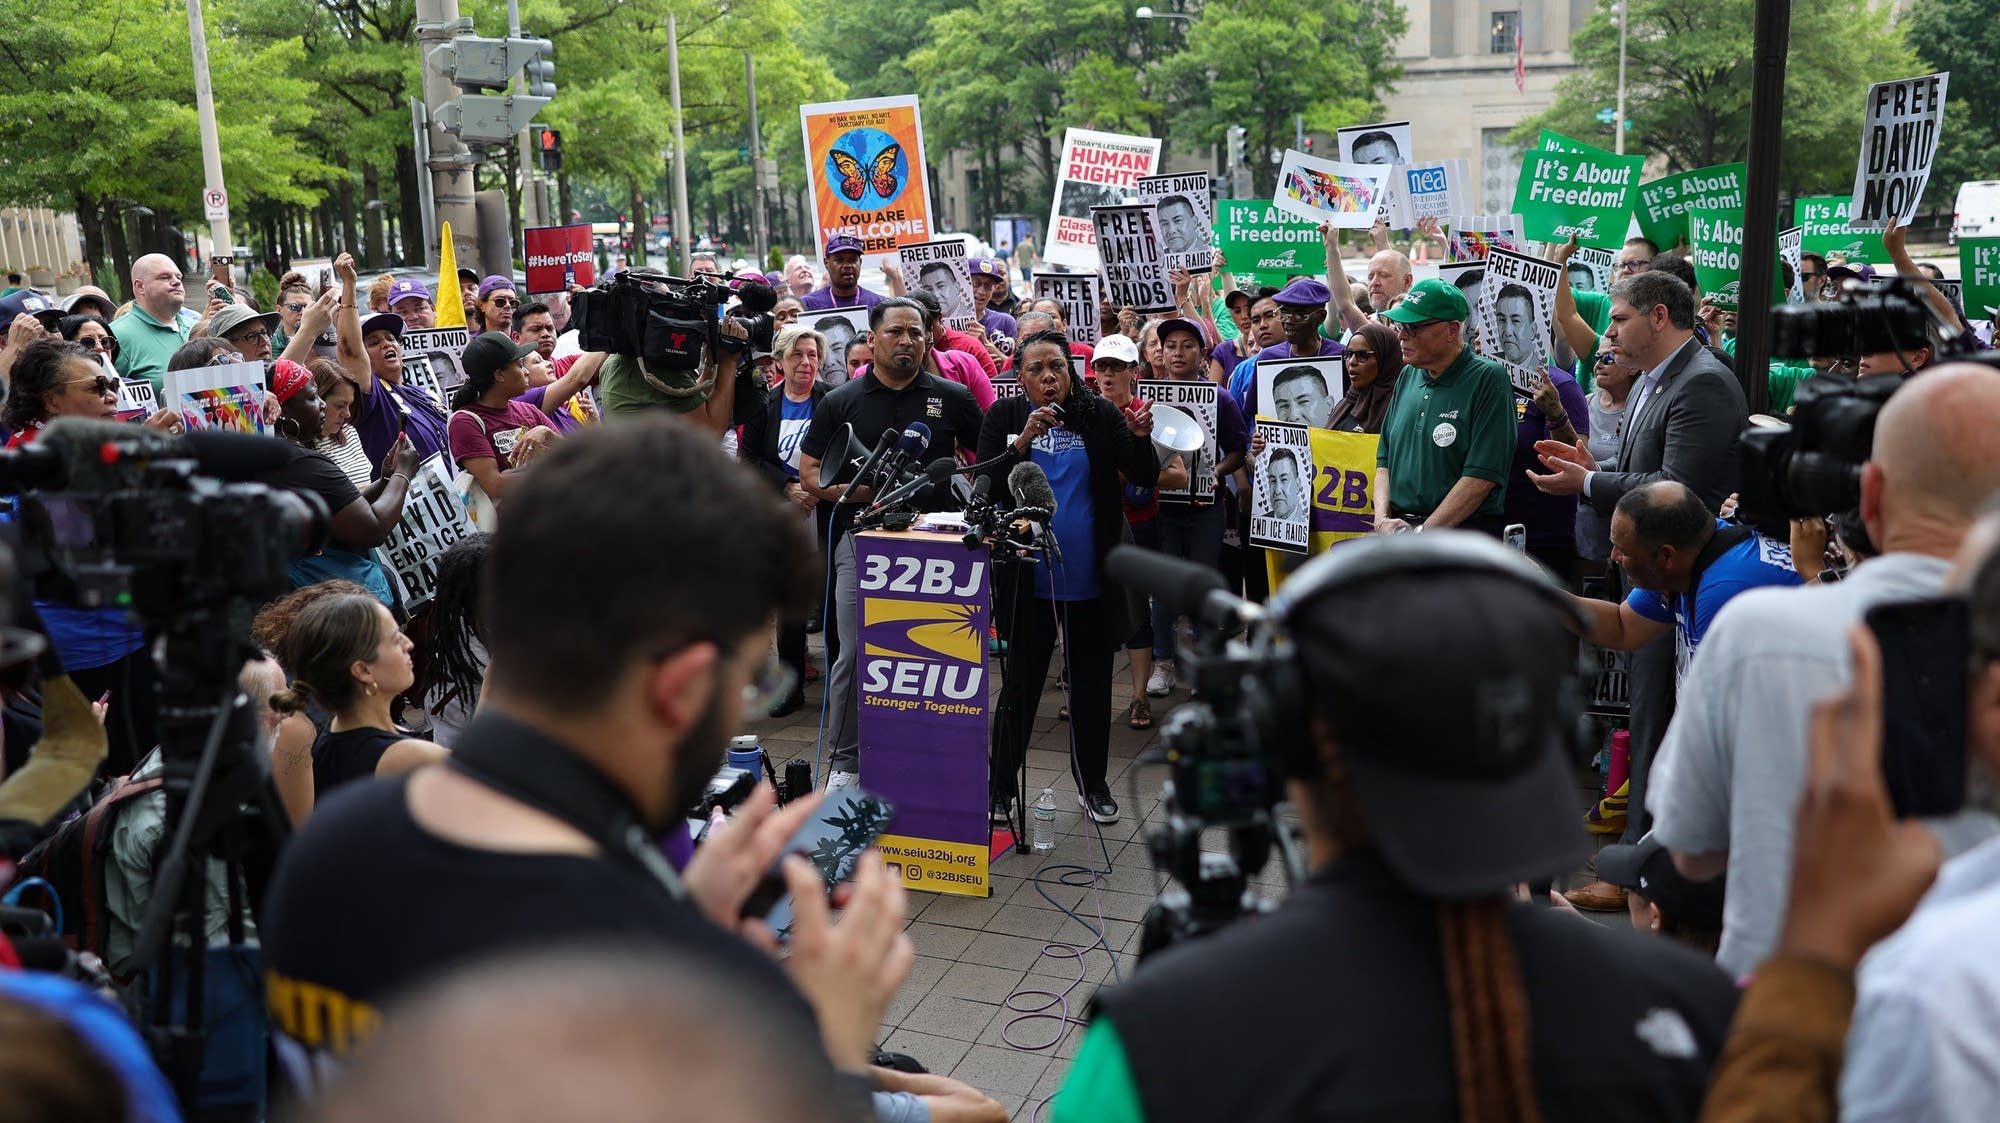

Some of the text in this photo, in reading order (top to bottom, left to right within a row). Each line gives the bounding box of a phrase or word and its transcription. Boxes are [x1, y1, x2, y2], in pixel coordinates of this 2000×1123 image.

[1875, 78, 1940, 119] FREE
[1072, 139, 1101, 149] TODAY'S
[1102, 143, 1130, 152] LESSON
[1868, 119, 1935, 174] DAVID
[1071, 147, 1151, 171] HUMAN
[1068, 163, 1146, 189] RIGHTS
[1410, 170, 1446, 193] nea
[1535, 158, 1631, 185] It's About
[1139, 176, 1207, 195] FREE DAVID
[1529, 180, 1627, 208] Freedom!
[1642, 172, 1739, 207] It's About
[1649, 190, 1742, 224] Freedom!
[1861, 175, 1924, 221] NOW
[840, 209, 906, 226] YOU ARE
[1230, 206, 1259, 224] It's
[1804, 203, 1831, 220] It's
[823, 219, 925, 240] WELCOME
[1099, 211, 1154, 236] FREE
[1230, 225, 1321, 243] Freedom!
[1693, 216, 1710, 242] It's
[1057, 230, 1084, 244] Not
[1779, 231, 1800, 251] DAVID
[528, 250, 593, 268] #HereToStay
[901, 243, 966, 263] FREE DAVID
[1102, 235, 1158, 264] DAVID
[1166, 251, 1212, 270] ICE RAIDS
[1584, 250, 1612, 267] DAVID
[1107, 264, 1161, 281] END ICE
[1487, 254, 1558, 290] FREE DAVID
[1039, 279, 1092, 301] FREE
[1110, 281, 1168, 308] RAIDS
[403, 331, 468, 351] REE DAVID
[1072, 328, 1095, 342] ICE
[1140, 385, 1215, 404] FREE DAVID
[1258, 425, 1309, 447] FREE DAVID
[1311, 464, 1374, 509] 2B
[1251, 517, 1308, 544] END ICE RAIDS
[389, 521, 467, 571] END ICE
[859, 554, 985, 597] 32BJ
[862, 659, 983, 700] SEIU
[864, 695, 983, 716] Stronger Together
[926, 869, 983, 886] @32BJSEIU
